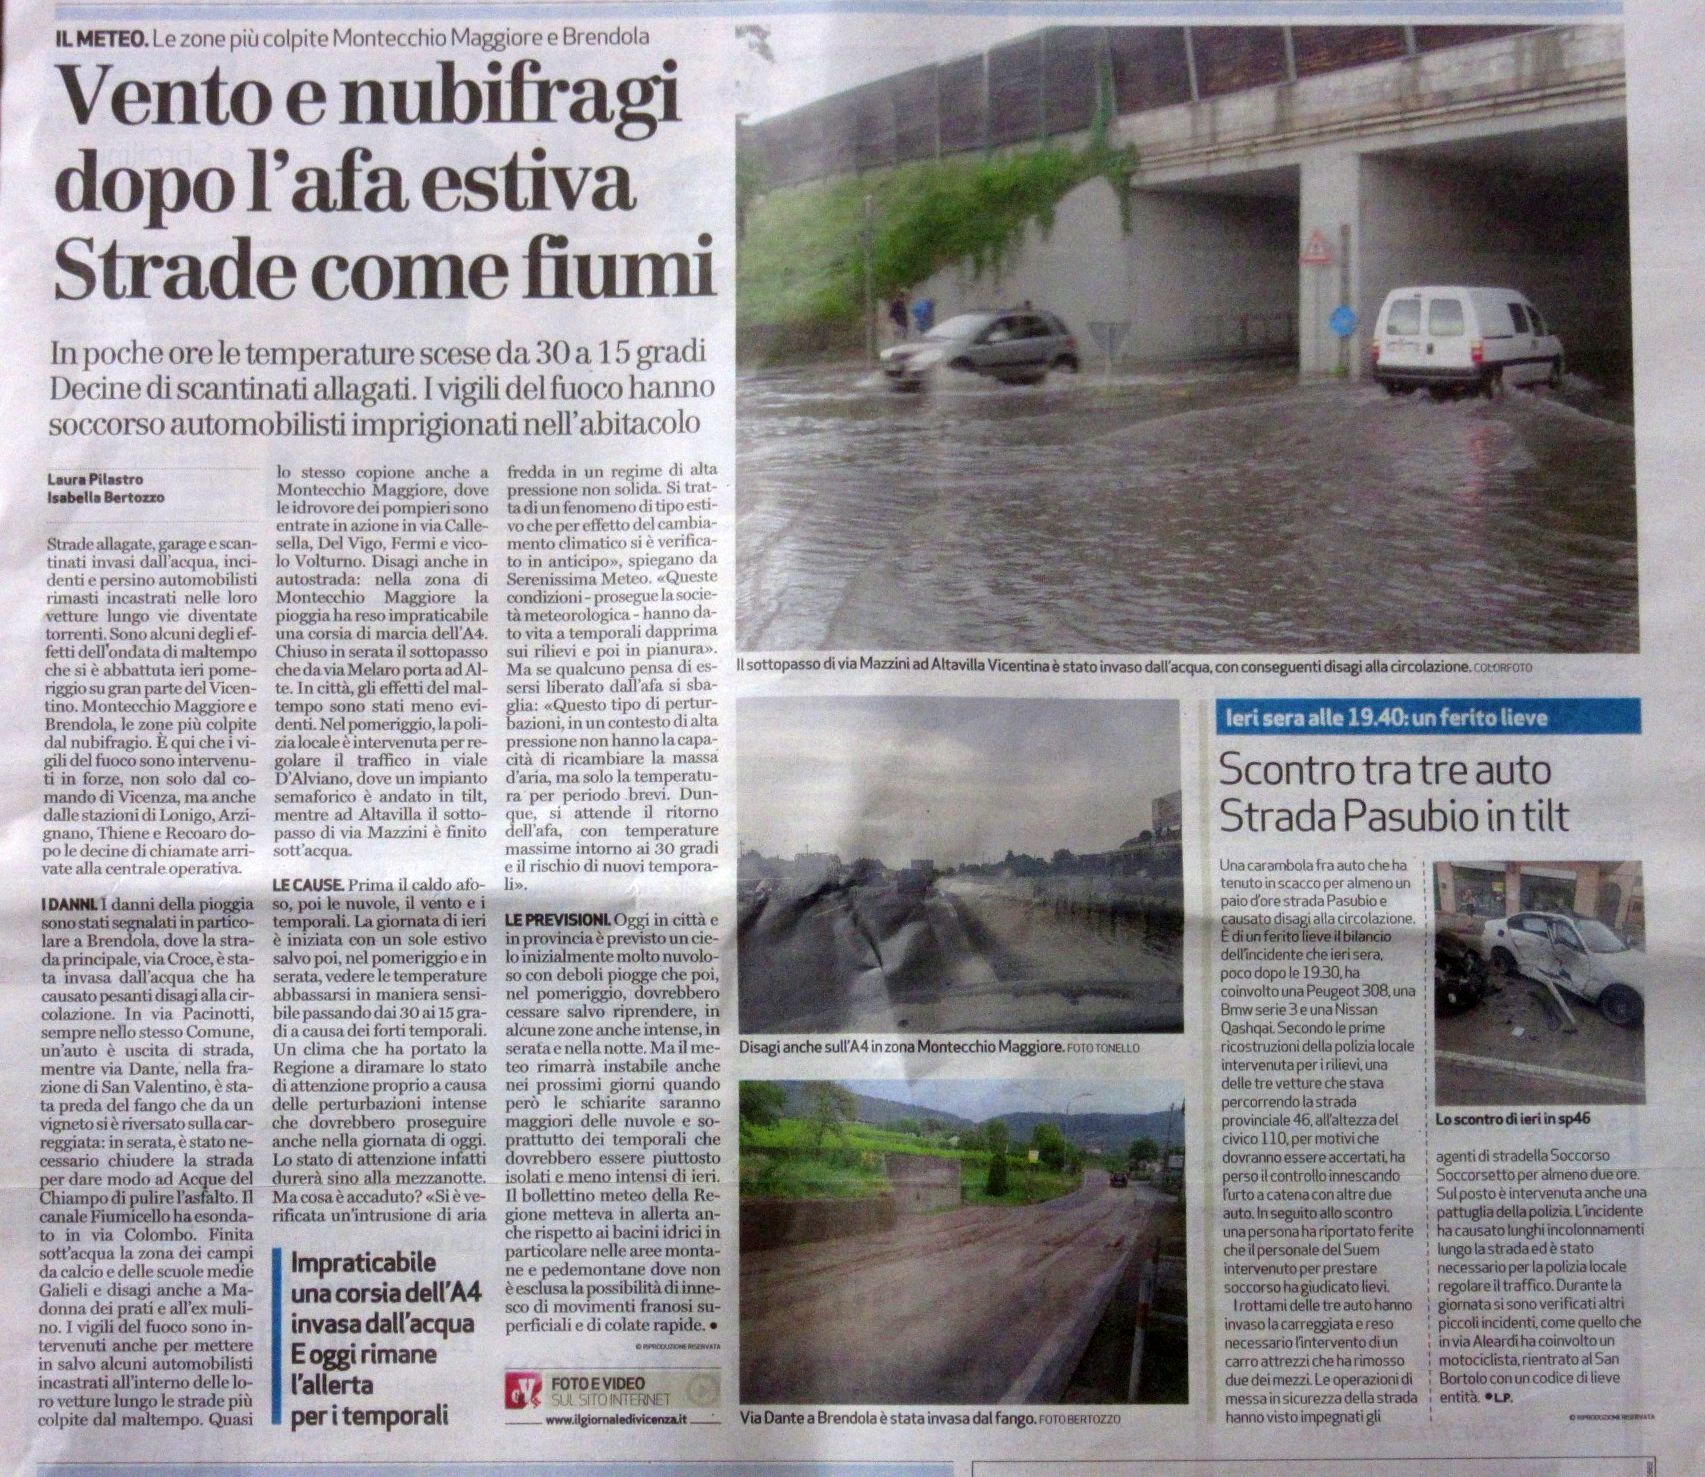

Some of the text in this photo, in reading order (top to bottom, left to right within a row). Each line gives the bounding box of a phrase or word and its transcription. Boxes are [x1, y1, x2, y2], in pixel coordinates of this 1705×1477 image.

[55, 26, 650, 53] IL METEO. Le zone più colpite Montecchio Maggiore e Brendola
[54, 58, 683, 142] Vento e nubifragi
[54, 146, 638, 230] dopo l'afa estiva
[54, 232, 718, 301] Strade come fiumi
[51, 337, 707, 372] In poche ore le temperature scese da 30 a 15 gradi
[50, 373, 716, 408] Decine di scantinati allagati. I vigili del fuoco hanno
[48, 408, 701, 443] soccorso automobilisti imprigionati nell'abitacolo
[47, 472, 144, 486] Laura Pilastro
[47, 490, 166, 505] Isabella Bertozzo
[45, 607, 258, 625] vetture lungo vie diventate
[736, 657, 745, 672] Il
[746, 658, 821, 674] sottopasso
[823, 656, 836, 670] di
[837, 656, 858, 670] via
[859, 655, 911, 670] Mazzini
[912, 656, 930, 671] ad
[930, 656, 986, 672] Altavilla
[987, 656, 1049, 673] Vicentina
[1051, 658, 1061, 673] è
[1062, 660, 1098, 674] stato
[1099, 659, 1143, 674] invaso
[1144, 659, 1214, 678] dall'acqua,
[1215, 664, 1238, 673] con
[1240, 659, 1323, 678] conseguenti
[1323, 659, 1363, 678] disagi
[1364, 659, 1389, 674] alla
[1390, 659, 1472, 673] circolazione.
[1226, 706, 1549, 727] Ieri sera alle 19.40: un ferito lieve
[1219, 750, 1552, 786] Scontro tra tre auto
[1220, 797, 1571, 833] Strada Pasubio in tilt
[272, 878, 291, 893] LE
[41, 897, 47, 912] I
[100, 897, 108, 912] I
[111, 896, 156, 912] danni
[158, 896, 196, 912] della
[198, 896, 255, 915] pioggia
[504, 913, 523, 927] LE
[739, 1039, 1141, 1058] Disagi anche sull'A4 in zona Montecchio Maggiore. FOTO TONELLO
[505, 1094, 721, 1114] però le schiarite saranno
[1435, 1110, 1592, 1129] Lo scontro di ieri in sp46
[1435, 1147, 1611, 1167] agenti di stradella Soccorso
[291, 1249, 438, 1280] Impraticabile
[291, 1279, 483, 1304] una corsia dell'A4
[291, 1311, 475, 1340] invasa dall'acqua
[291, 1342, 438, 1372] E oggi rimane
[291, 1373, 374, 1396] l'allerta
[551, 1376, 646, 1391] FOTO E VIDEO
[578, 1390, 608, 1407] SITO
[609, 1390, 672, 1407] INTERNET
[291, 1402, 449, 1433] per i temporali
[739, 1410, 1120, 1429] Via Dante a Brendola è stata invasa dal fango. FOTO BERTOZZO
